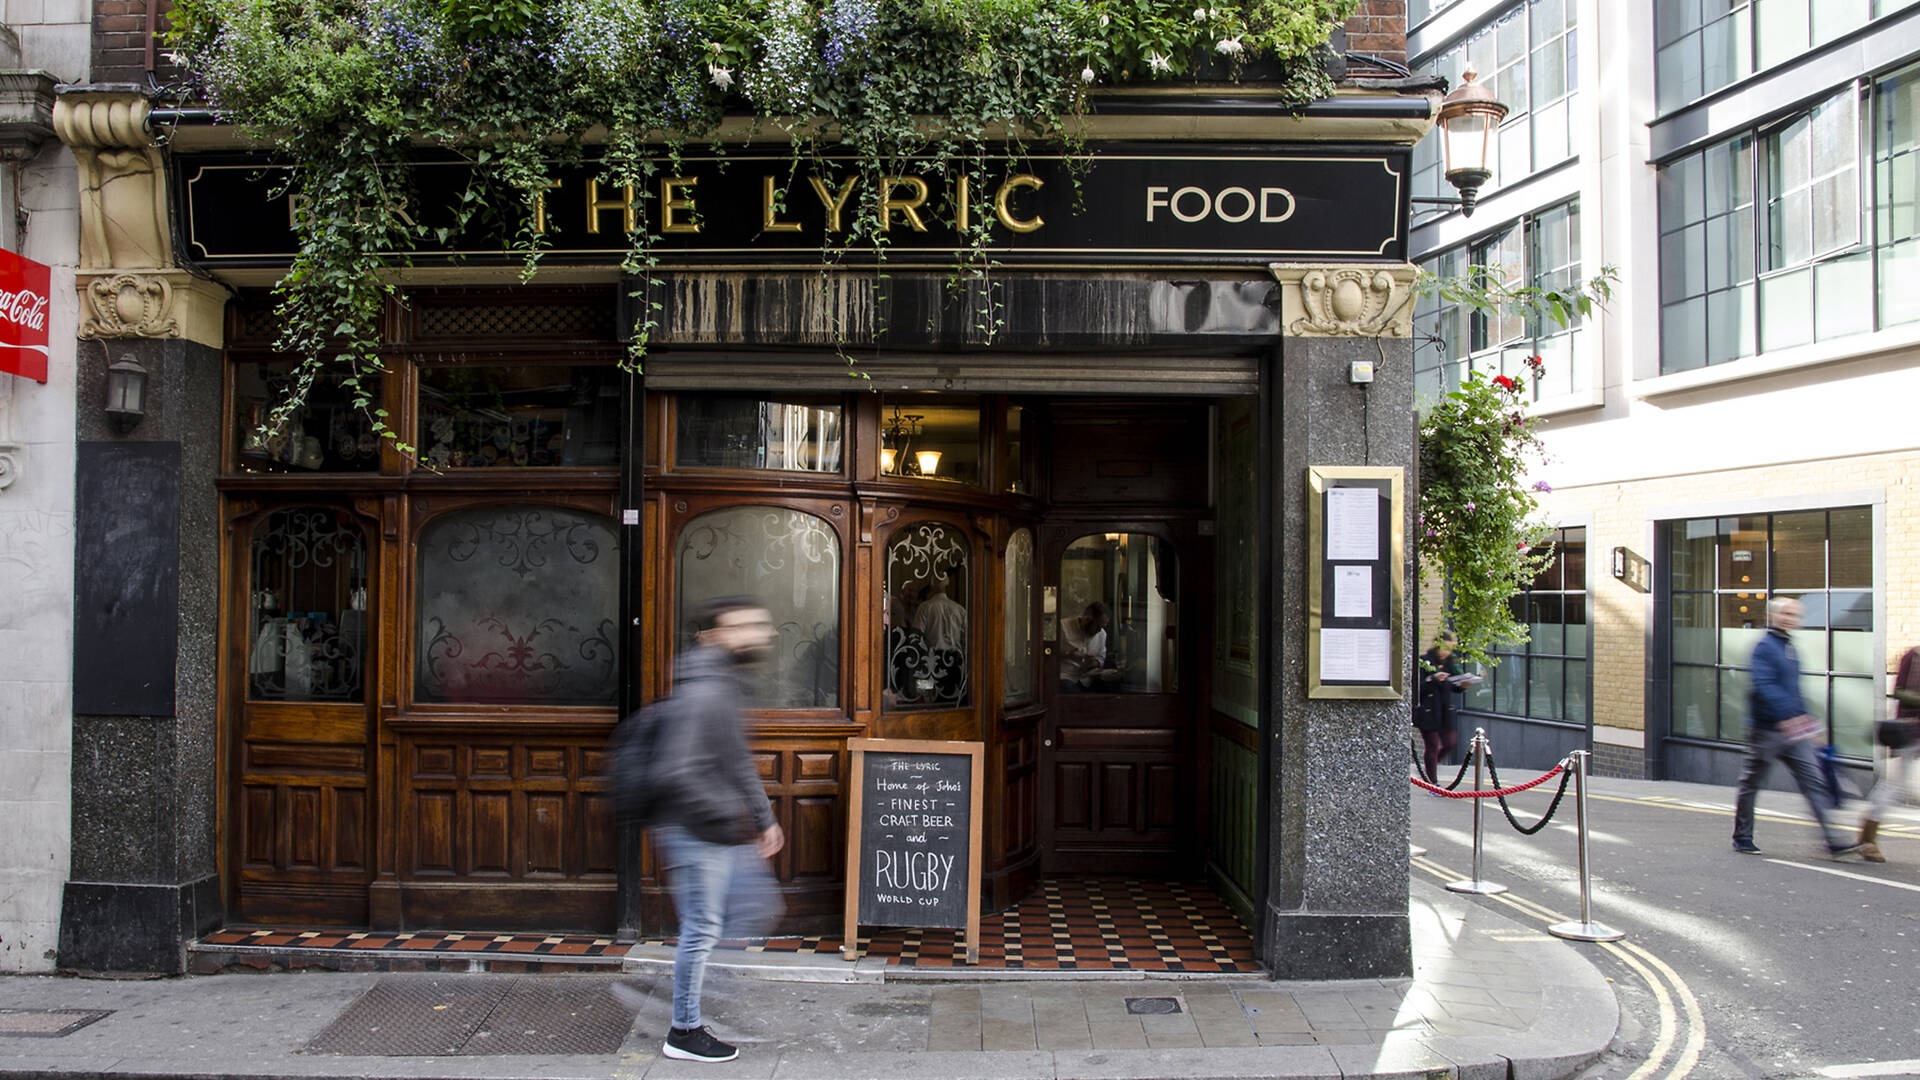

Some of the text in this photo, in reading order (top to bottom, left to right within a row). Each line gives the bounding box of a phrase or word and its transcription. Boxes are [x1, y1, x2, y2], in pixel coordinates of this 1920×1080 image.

[513, 174, 1045, 234] THE LYRIC
[1146, 186, 1296, 223] FOOD
[891, 761, 910, 771] THE
[876, 778, 908, 791] Home
[915, 781, 929, 795] of
[891, 799, 938, 810] FINEST
[879, 815, 954, 827] CRAFT BEER
[906, 832, 928, 844] and
[876, 850, 954, 891] RUGBY
[876, 893, 940, 906] WORLD CUP
